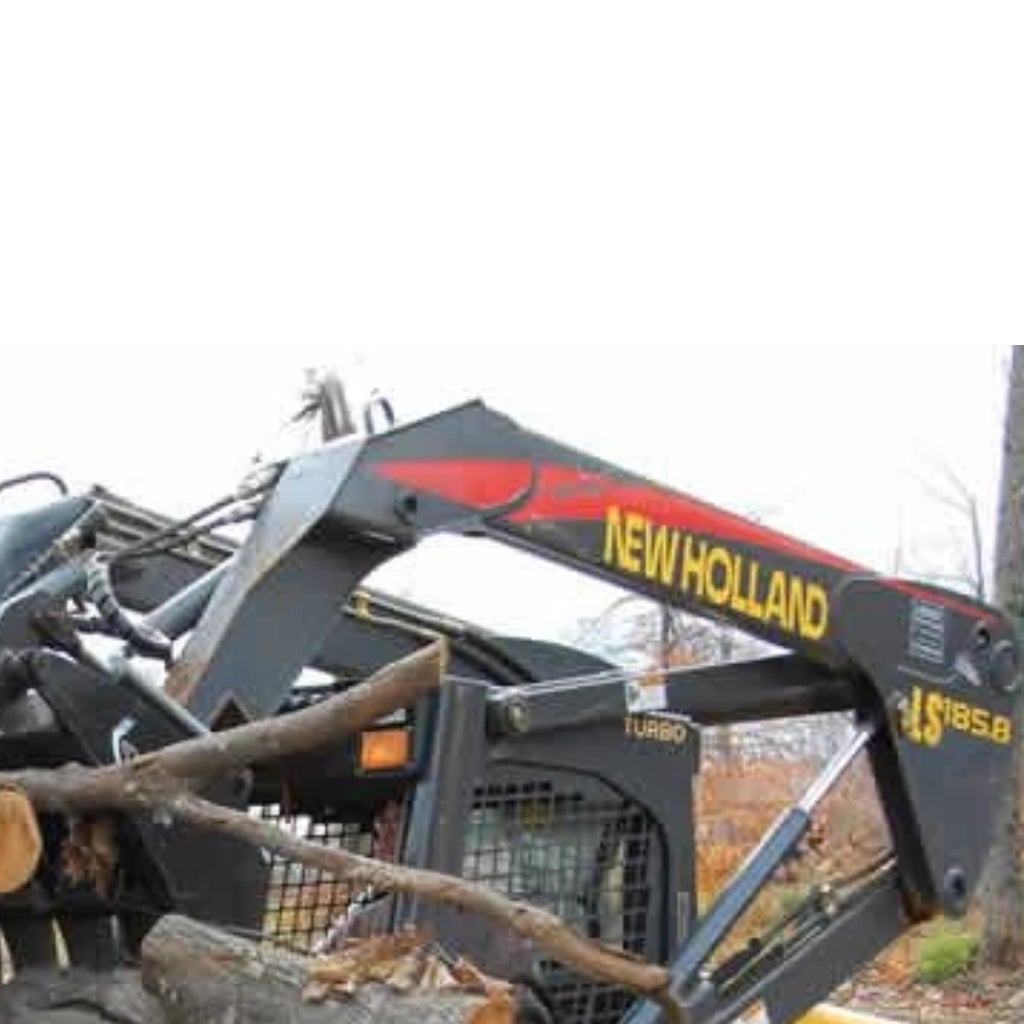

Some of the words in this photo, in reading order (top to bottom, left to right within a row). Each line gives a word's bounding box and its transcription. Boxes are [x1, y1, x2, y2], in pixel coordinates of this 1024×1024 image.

[603, 503, 680, 587] NEW
[681, 535, 829, 640] HOLLAND
[623, 716, 688, 744] TURBO
